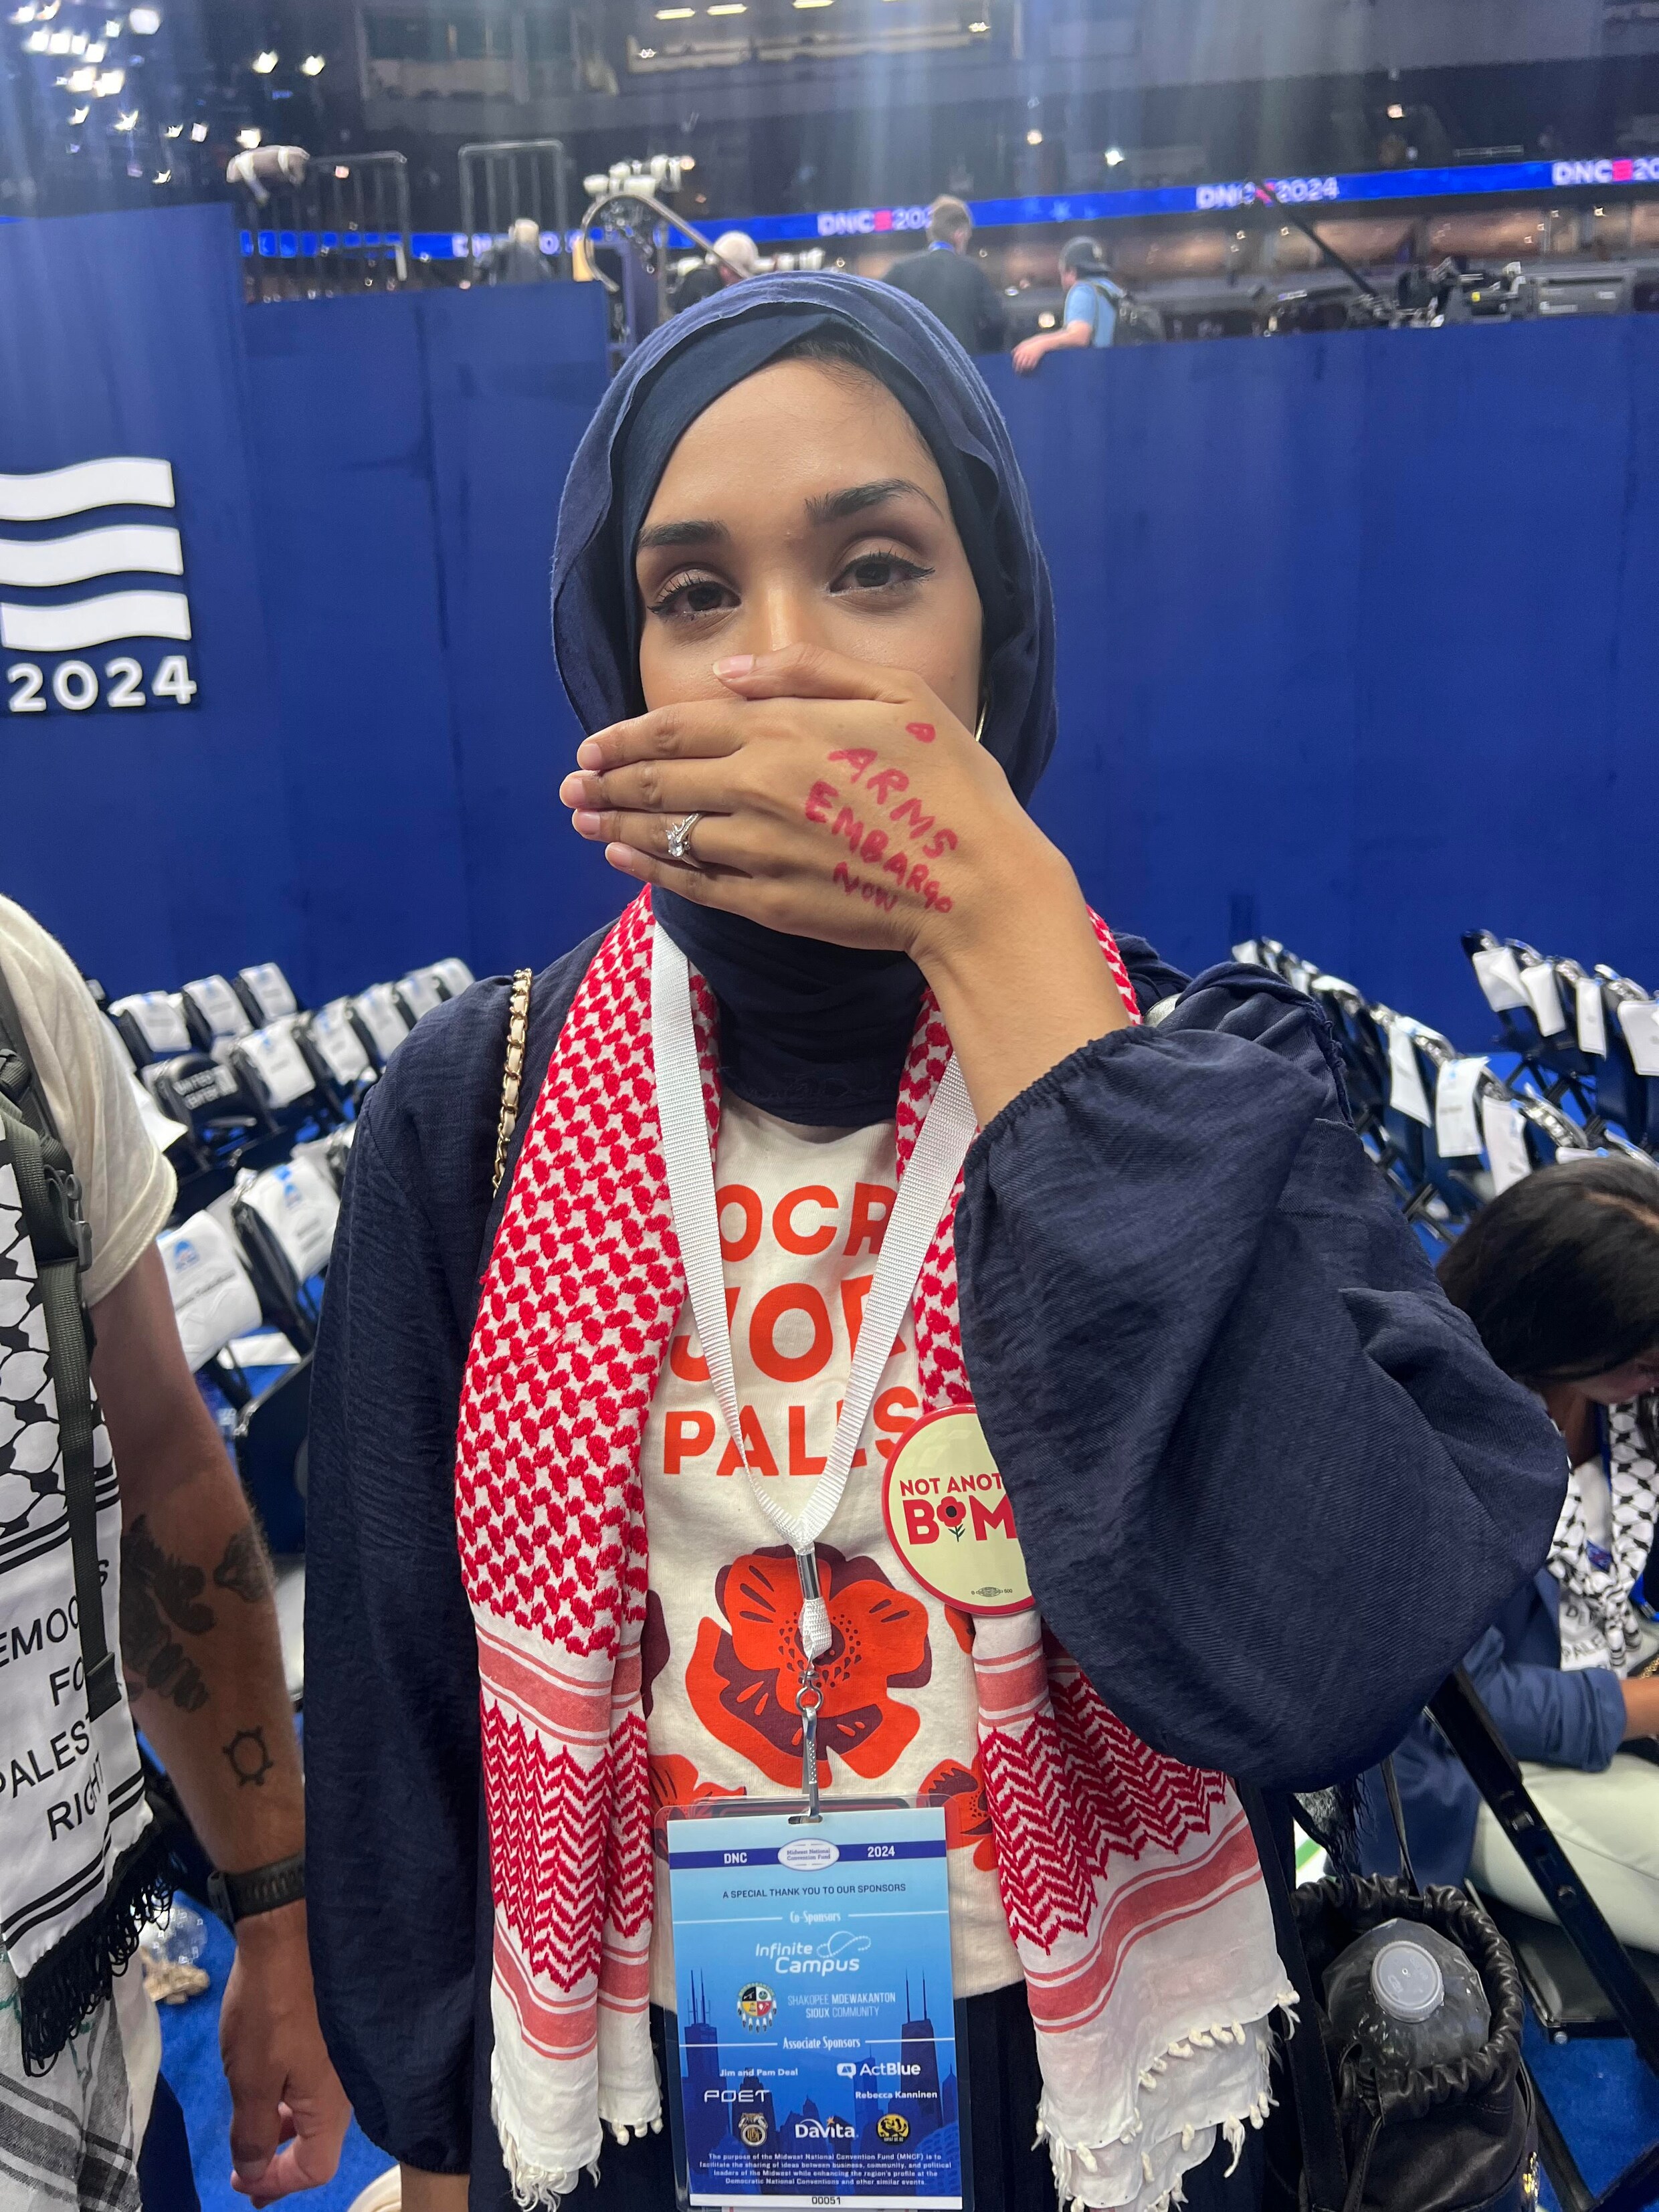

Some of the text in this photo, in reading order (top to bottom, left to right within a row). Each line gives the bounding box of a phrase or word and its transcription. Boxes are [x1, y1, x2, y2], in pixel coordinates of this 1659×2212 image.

[1551, 159, 1613, 186] DNC
[1276, 177, 1339, 203] 2024
[892, 207, 933, 231] 20
[7, 656, 197, 712] 2024
[827, 748, 958, 859] ARMS
[832, 861, 898, 912] NOW
[900, 1473, 1002, 1496] NOT ANOT
[50, 1657, 84, 1706] FO
[0, 1712, 90, 1799] ALES
[724, 1852, 747, 1864] DNC
[868, 1845, 895, 1857] 2024
[730, 1889, 767, 1898] SPECIAL
[769, 1888, 800, 1897] THANK
[802, 1887, 820, 1896] YOU
[822, 1886, 834, 1895] TO
[836, 1886, 856, 1894] OUR
[858, 1884, 906, 1893] SPONSORS
[755, 1942, 813, 1960] Infinite
[775, 1956, 860, 1977] Campus
[787, 1992, 896, 2006] SHAKOPEE MDEWAKANTON
[806, 2007, 879, 2019] SIOUX COMMUNITY
[783, 2036, 860, 2051] Associate Sponsors
[720, 2068, 798, 2077] Jim and Pam Deal
[860, 2062, 921, 2076] ActBlue
[704, 2090, 770, 2103] POET
[855, 2090, 938, 2100] Rebecca Kanninen
[795, 2119, 856, 2139] DaVita
[811, 2197, 841, 2205] 00051
